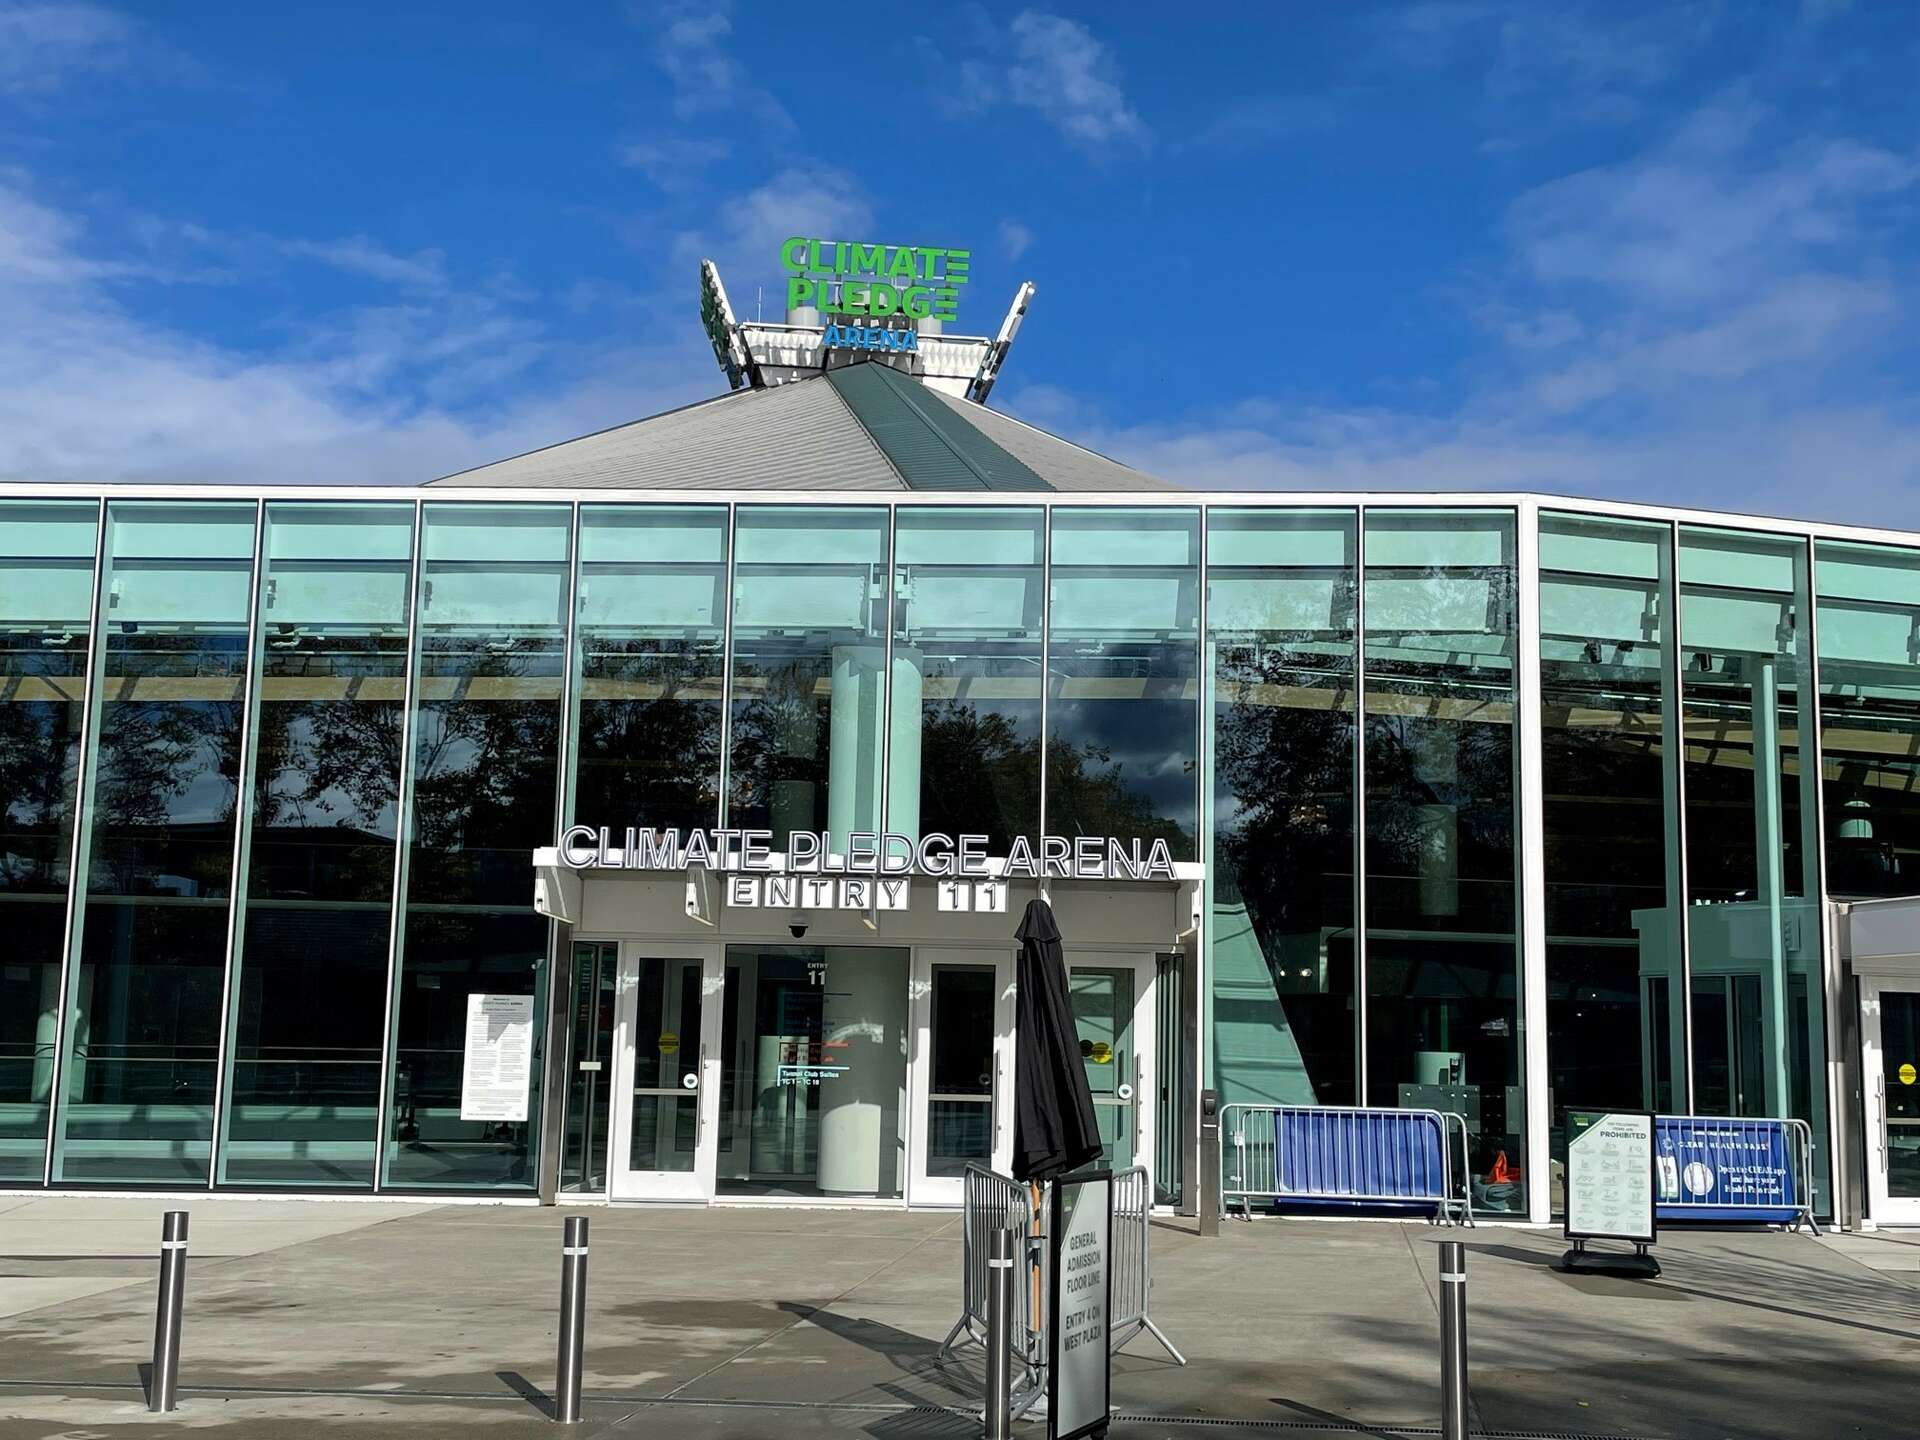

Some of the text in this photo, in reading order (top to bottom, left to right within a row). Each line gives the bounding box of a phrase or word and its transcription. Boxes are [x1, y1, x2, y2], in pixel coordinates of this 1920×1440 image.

[780, 237, 970, 285] CLIMATE
[787, 276, 959, 322] PLEDGE
[823, 324, 918, 350] ARENA
[560, 825, 1178, 880] CLIMATE PLEDGE ARENA
[731, 876, 999, 911] ENTRY 11
[808, 970, 826, 985] 11
[804, 1070, 818, 1078] Club
[1600, 1131, 1647, 1139] PROHIBITED
[1070, 1231, 1097, 1250] GENERAL
[1067, 1250, 1101, 1272] ADMISSION
[1067, 1270, 1101, 1294] FLOOR LINE
[1066, 1311, 1086, 1330] ENTRY
[1092, 1304, 1101, 1320] ON
[1064, 1324, 1102, 1351] WEST PLAZA
